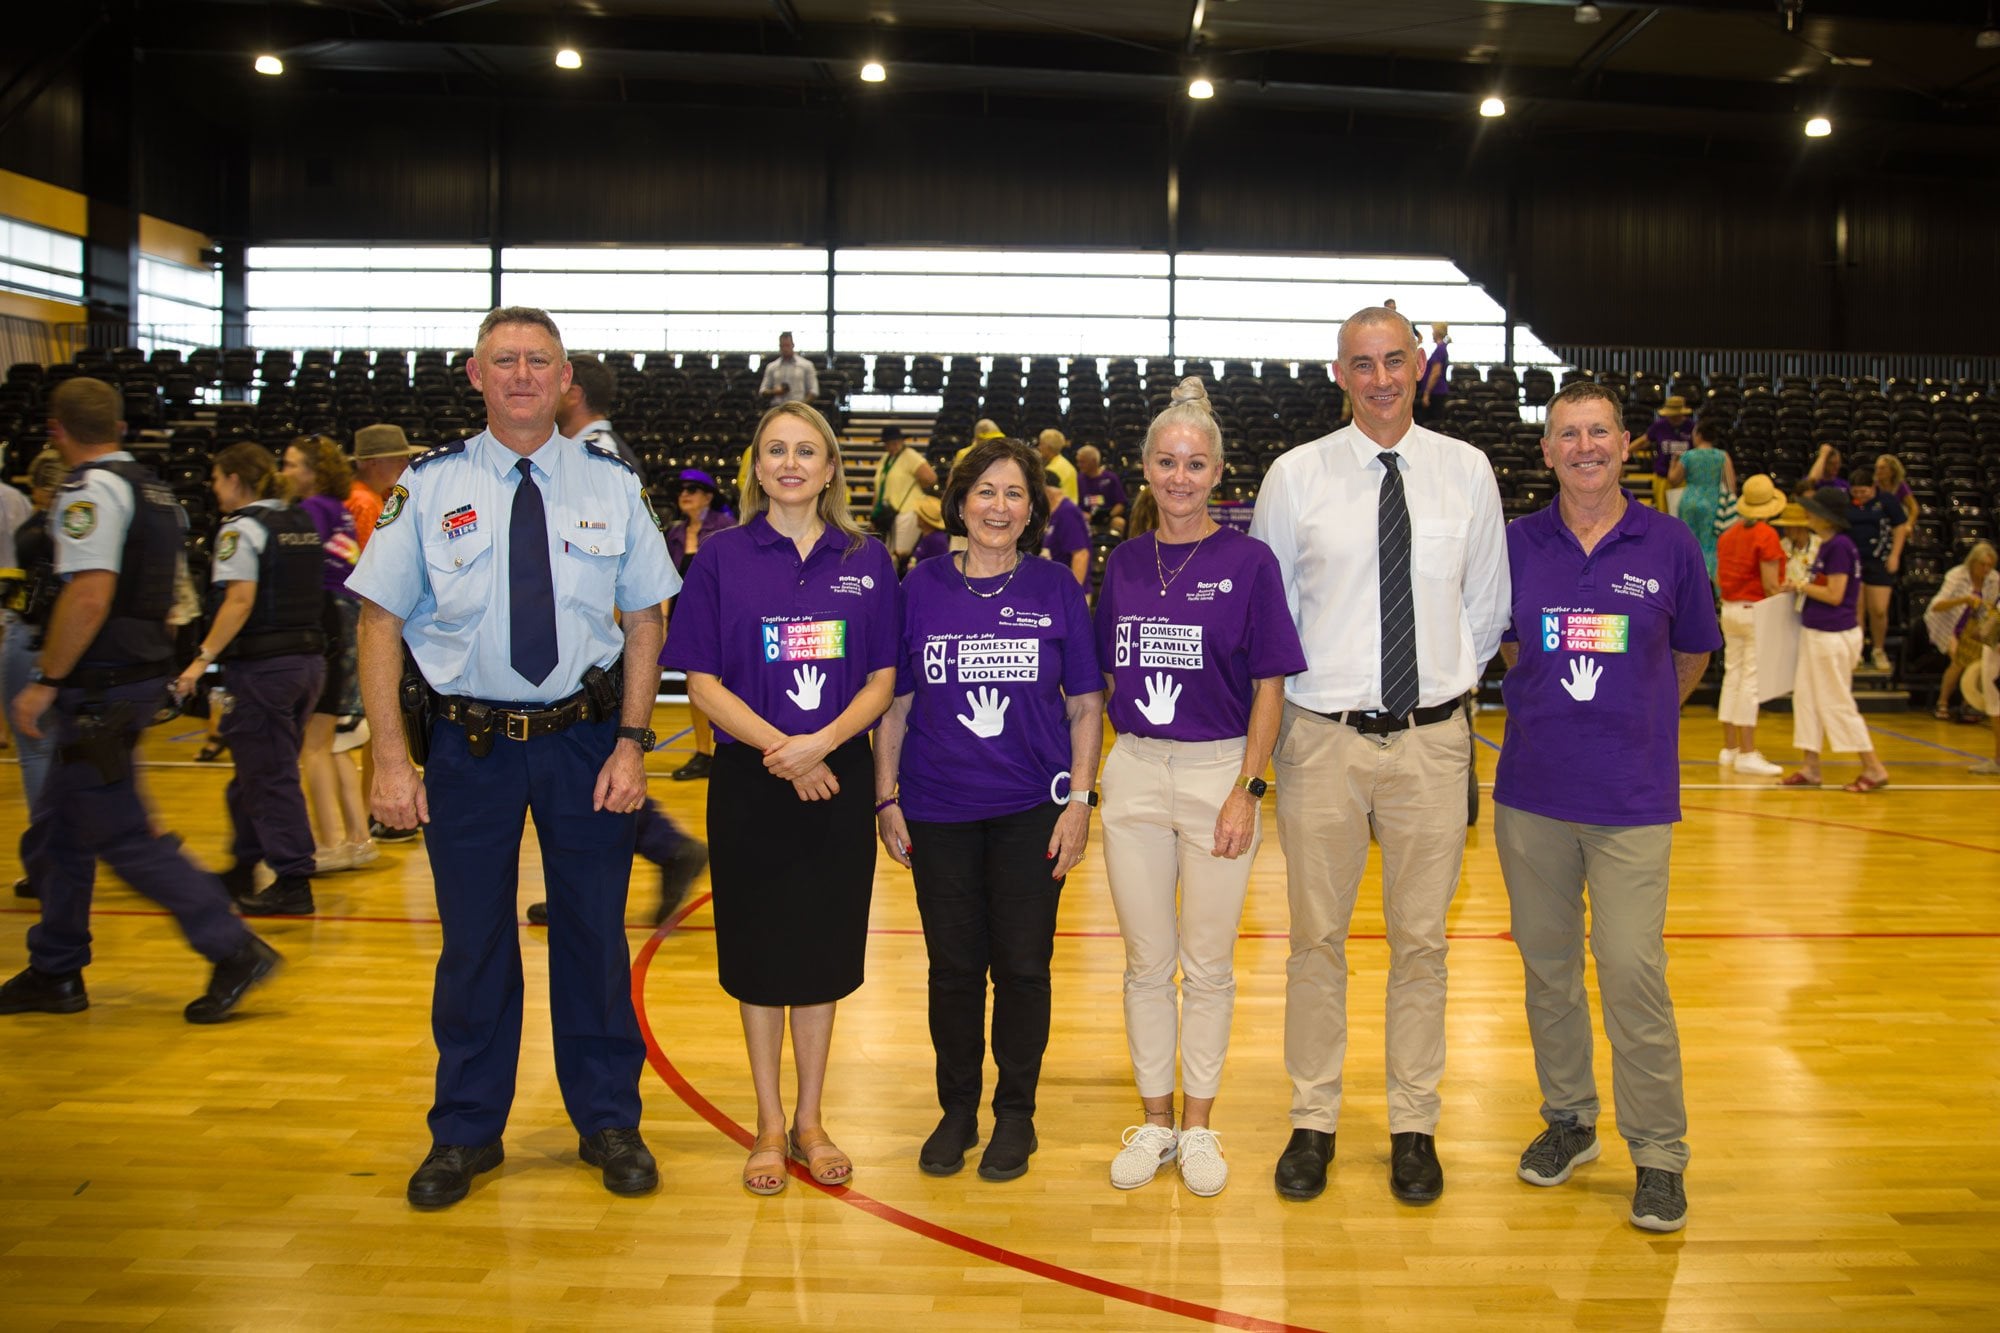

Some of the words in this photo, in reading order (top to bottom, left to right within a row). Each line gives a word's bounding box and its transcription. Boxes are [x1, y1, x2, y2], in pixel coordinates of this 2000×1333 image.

[278, 532, 320, 545] POLICE
[839, 575, 860, 584] Rotary
[1623, 573, 1646, 586] Rotary
[1197, 581, 1219, 589] Rotary
[1542, 606, 1571, 614] Together
[1016, 617, 1038, 625] Rotary
[1118, 614, 1146, 622] Together
[1567, 616, 1618, 626] DOMESTIC
[787, 623, 836, 634] DOMESTIC
[1142, 626, 1193, 637] DOMESTIC
[1567, 628, 1625, 638] FAMILY
[788, 635, 842, 646] FAMILY
[927, 633, 963, 641] Together
[961, 641, 1027, 651] DOMESTIC
[1142, 641, 1199, 652] FAMILY
[1567, 640, 1624, 650] VIOLENCE
[789, 647, 842, 658] VIOLENCE
[961, 655, 1036, 665] FAMILY
[1143, 655, 1201, 667] VIOLENCE
[961, 670, 1036, 679] VIOLENCE
